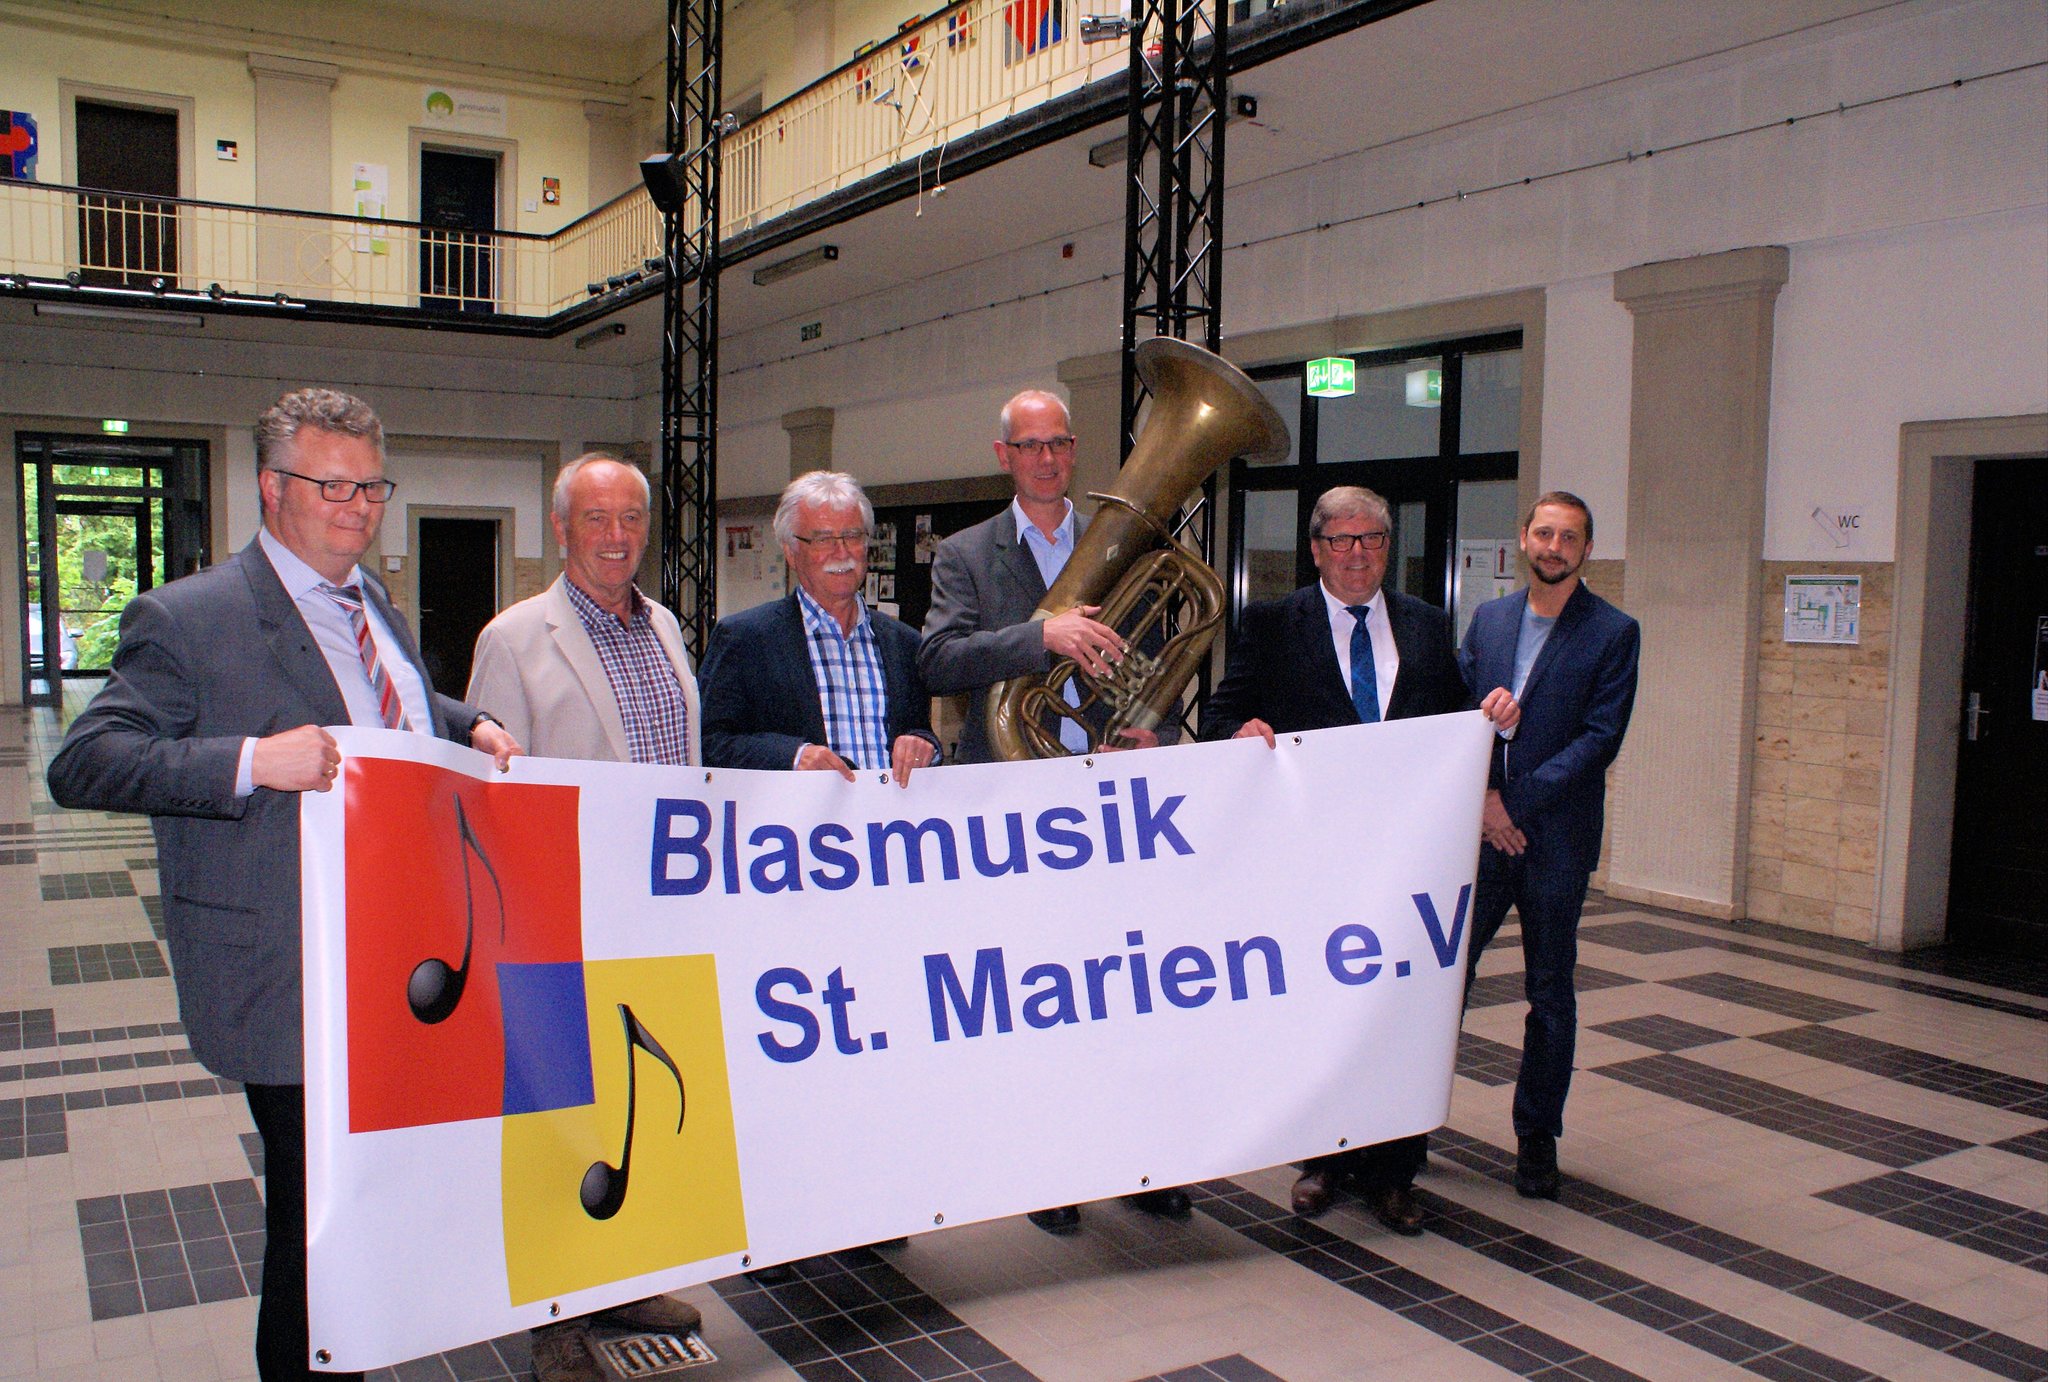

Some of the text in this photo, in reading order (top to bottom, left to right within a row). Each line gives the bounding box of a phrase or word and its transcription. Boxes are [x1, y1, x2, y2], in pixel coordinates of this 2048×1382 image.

[1838, 514, 1860, 529] WC
[650, 776, 1195, 897] Blasmusik
[755, 882, 1473, 1064] St. Marien e.V
